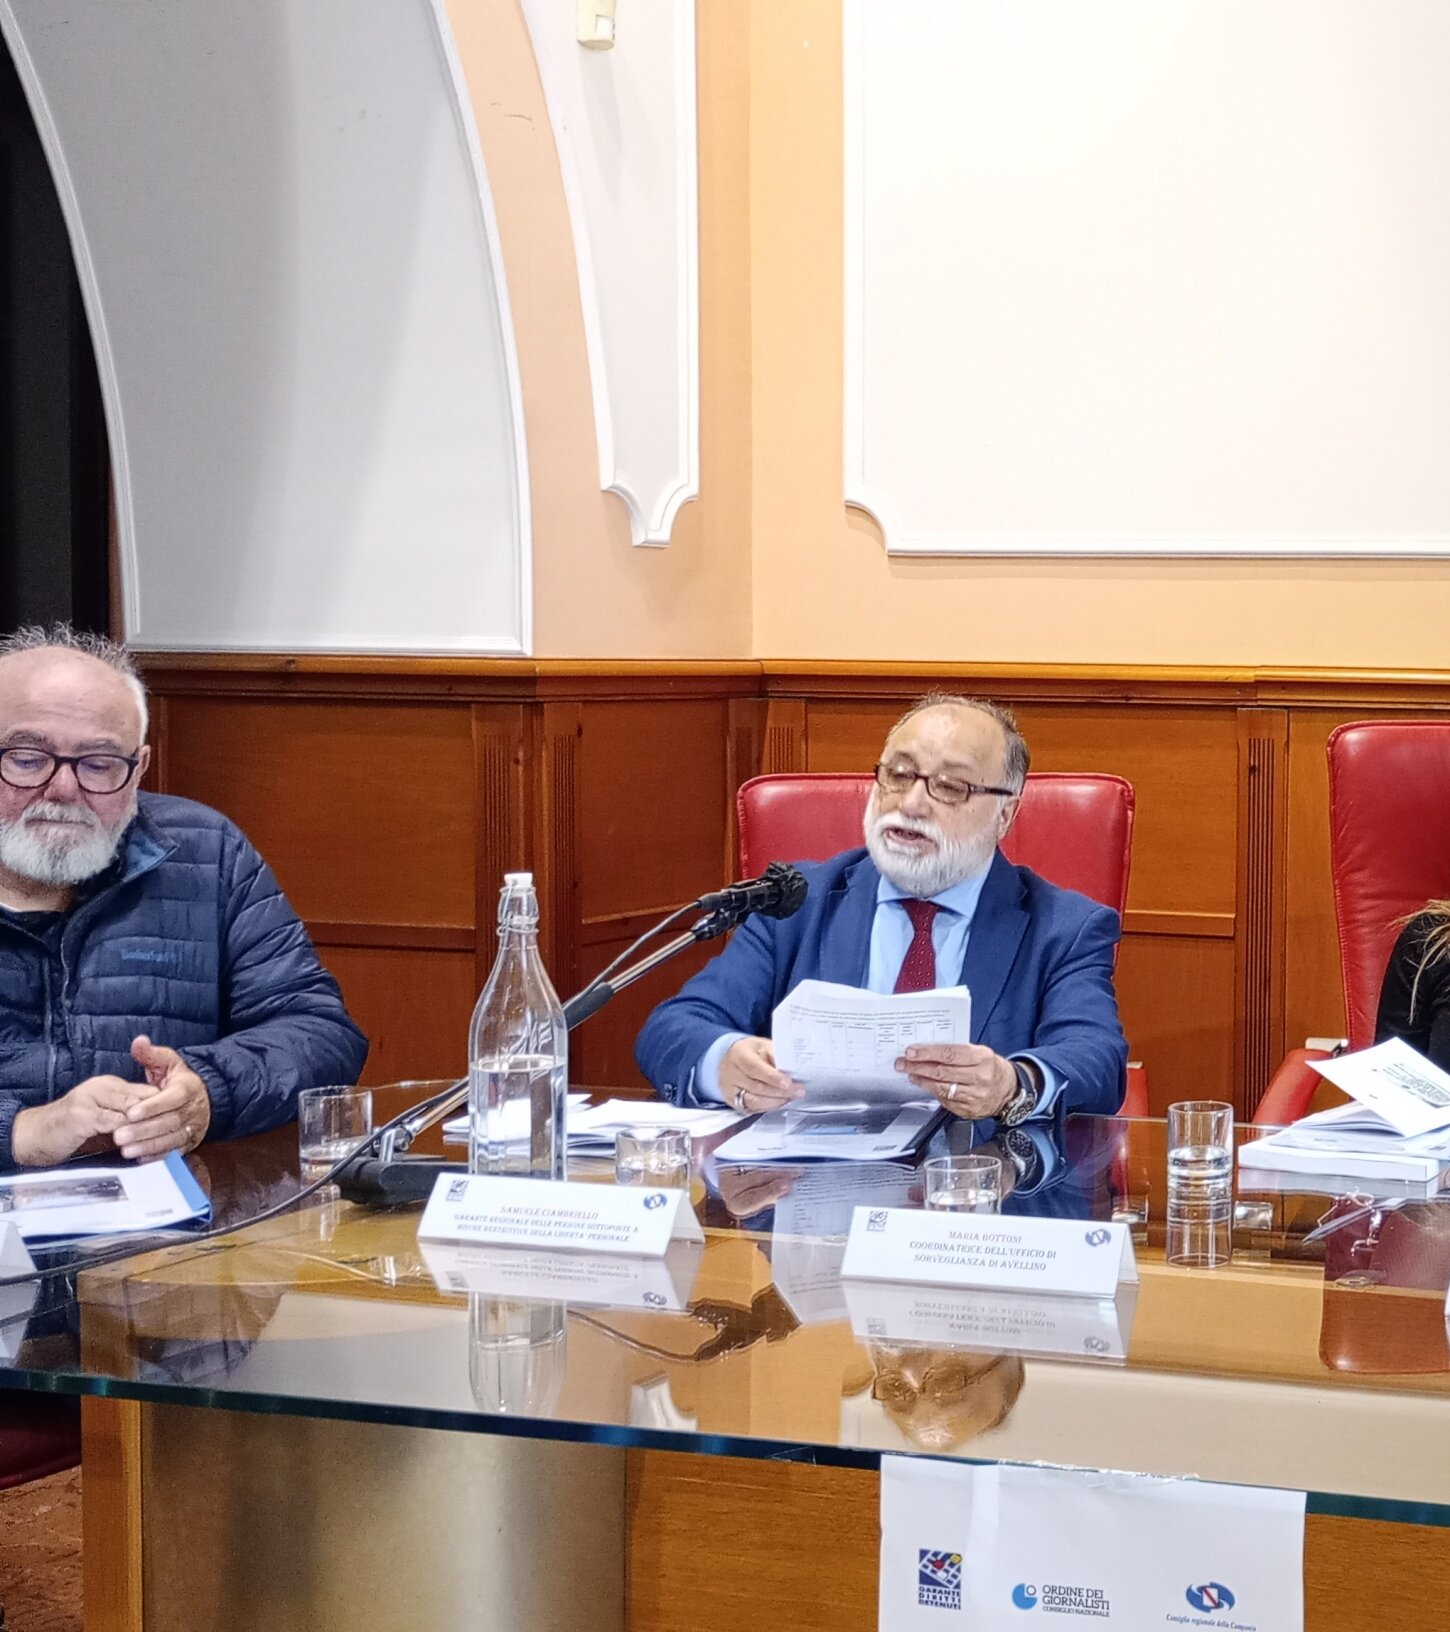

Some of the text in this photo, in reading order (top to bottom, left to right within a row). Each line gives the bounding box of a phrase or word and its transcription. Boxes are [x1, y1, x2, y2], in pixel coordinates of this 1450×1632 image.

[948, 1231, 1022, 1243] MARIA BOTTONI
[909, 1240, 1057, 1259] COORDINATRICE DELL'UFFICIO DI
[913, 1254, 1047, 1271] SORVEGLIANZA DI AVELLINO
[919, 1586, 960, 1597] GARANTE
[919, 1592, 961, 1603] DIRITTI
[1042, 1584, 1103, 1599] ORDINE DEI
[919, 1599, 961, 1610] DETENUTI
[1042, 1595, 1110, 1610] GIORNALISTI
[1043, 1605, 1110, 1617] CONSIGLIO NAZIONALE
[1166, 1613, 1190, 1624] Consiglio
[1216, 1620, 1230, 1628] della
